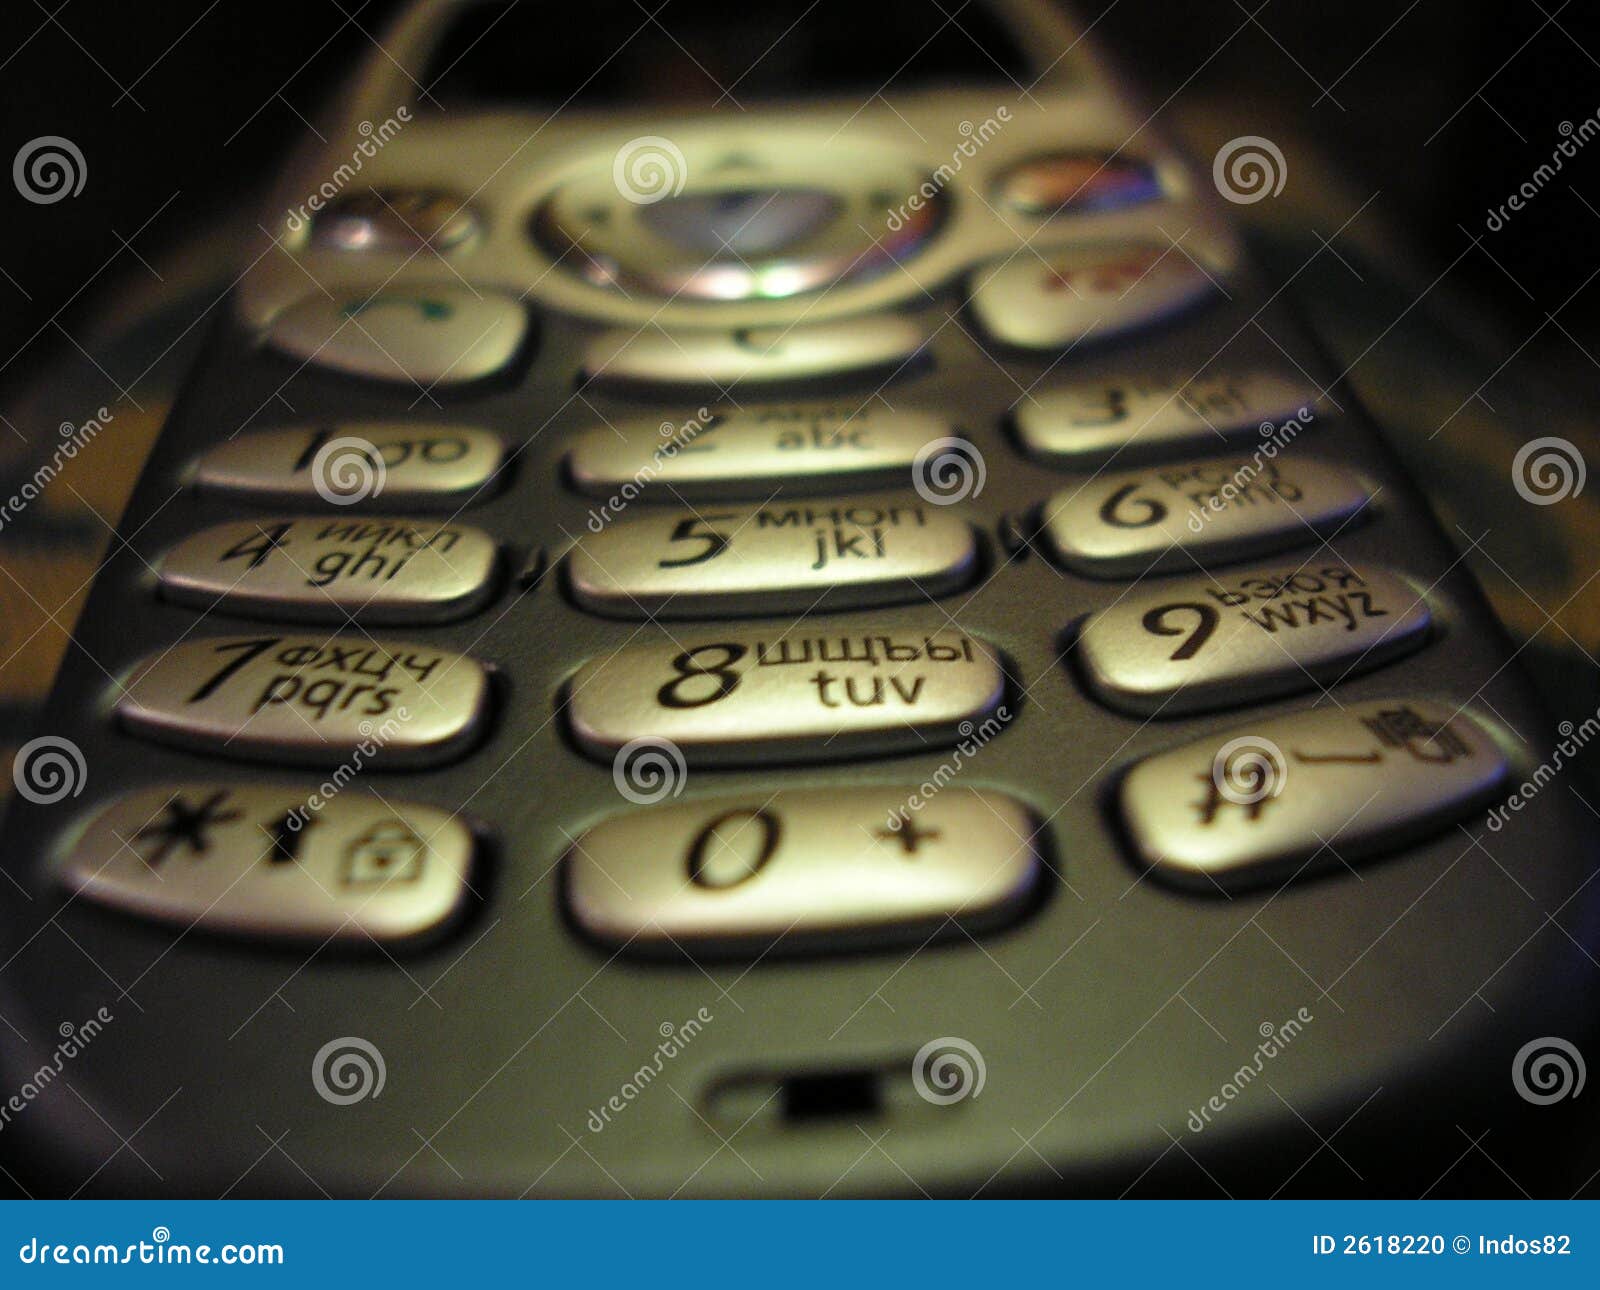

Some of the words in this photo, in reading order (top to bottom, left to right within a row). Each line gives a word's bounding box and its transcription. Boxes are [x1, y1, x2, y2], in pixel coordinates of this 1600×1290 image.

[1100, 484, 1169, 529] 6
[218, 523, 293, 570] 4
[658, 514, 742, 569] 5
[811, 527, 887, 571] jkl
[306, 546, 407, 587] ghi
[1142, 603, 1220, 661] 9
[1241, 592, 1390, 632] wxyz
[187, 638, 282, 703] 7
[657, 642, 749, 710] 8
[811, 670, 926, 707] tuv
[248, 674, 400, 722] pqrs
[685, 808, 783, 891] 0
